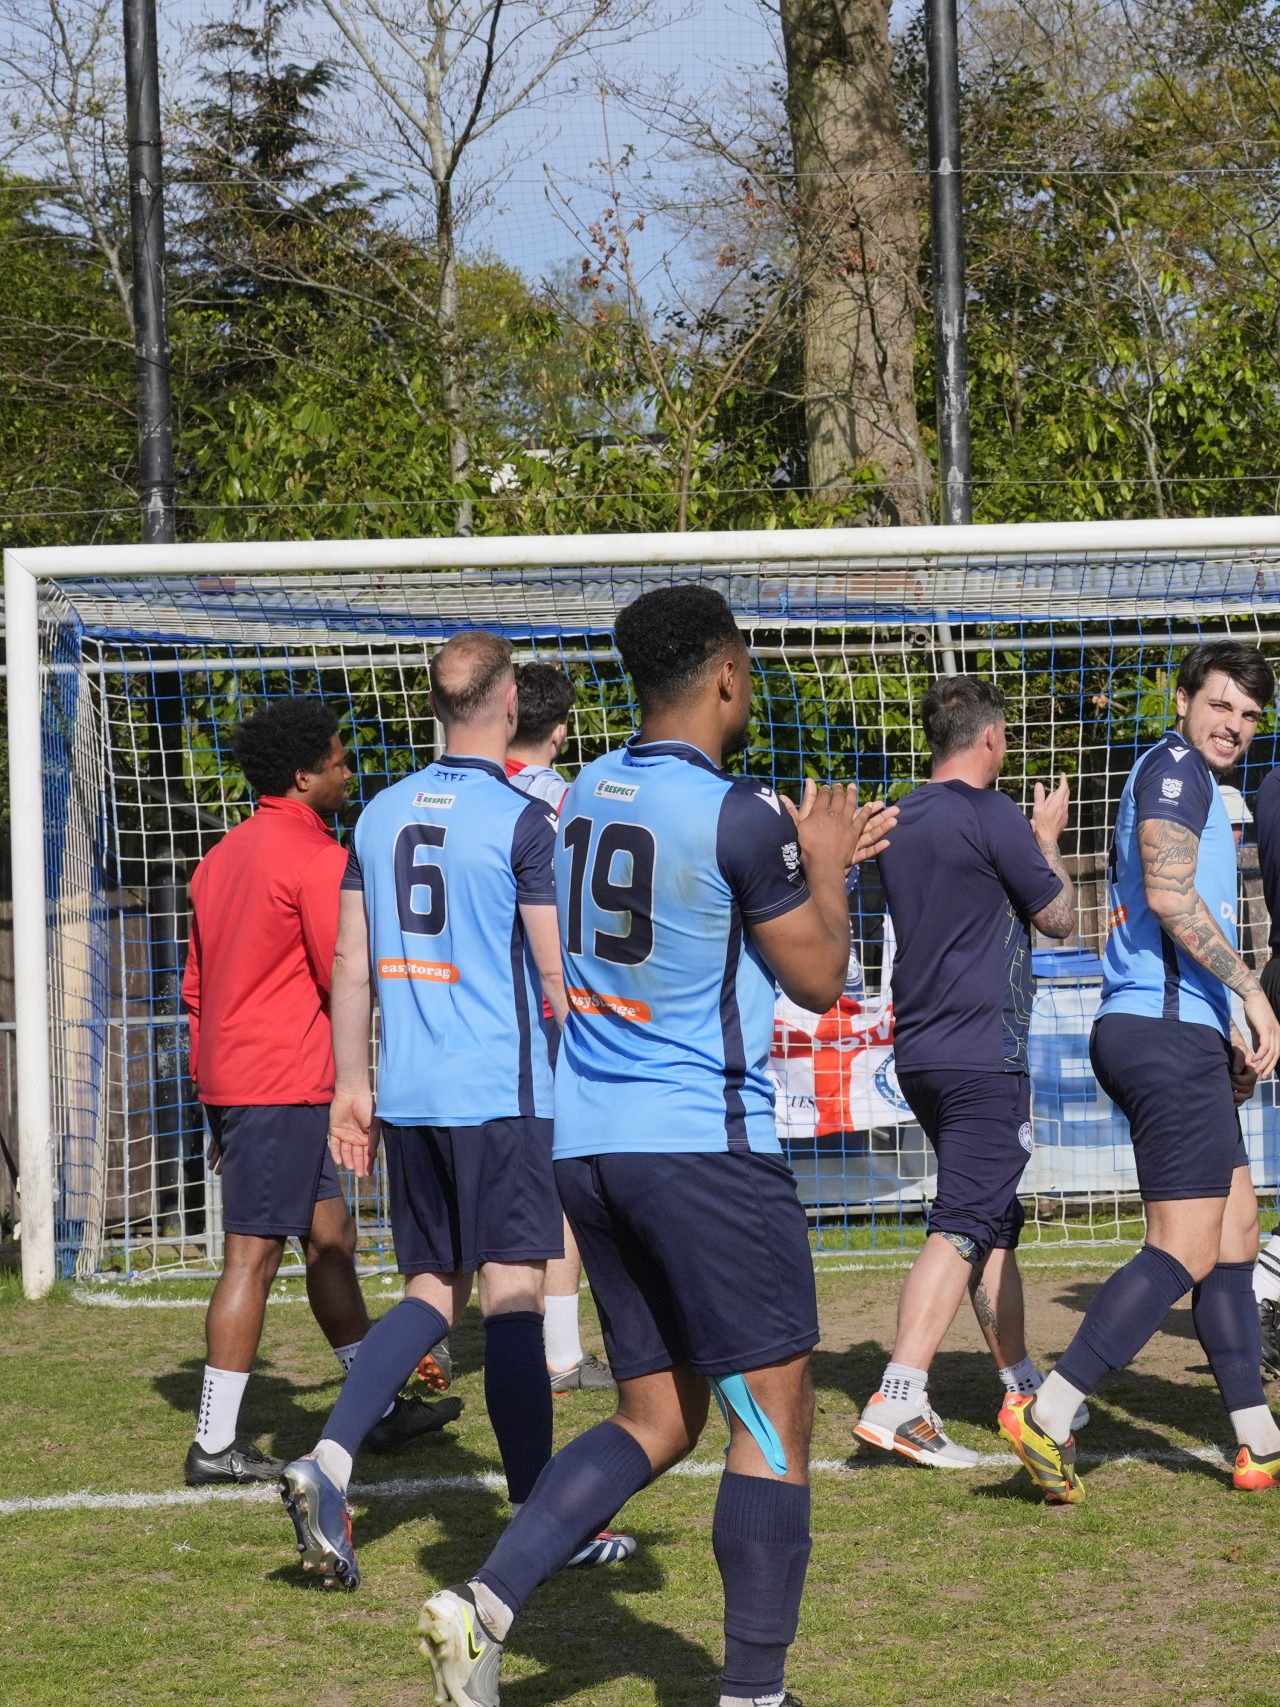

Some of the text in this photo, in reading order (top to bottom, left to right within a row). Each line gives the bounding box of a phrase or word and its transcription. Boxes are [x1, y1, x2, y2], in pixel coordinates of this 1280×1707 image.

[422, 796, 453, 805] RESPECT
[604, 784, 636, 797] RESPECT
[393, 822, 448, 937] 6
[563, 814, 657, 967] 19
